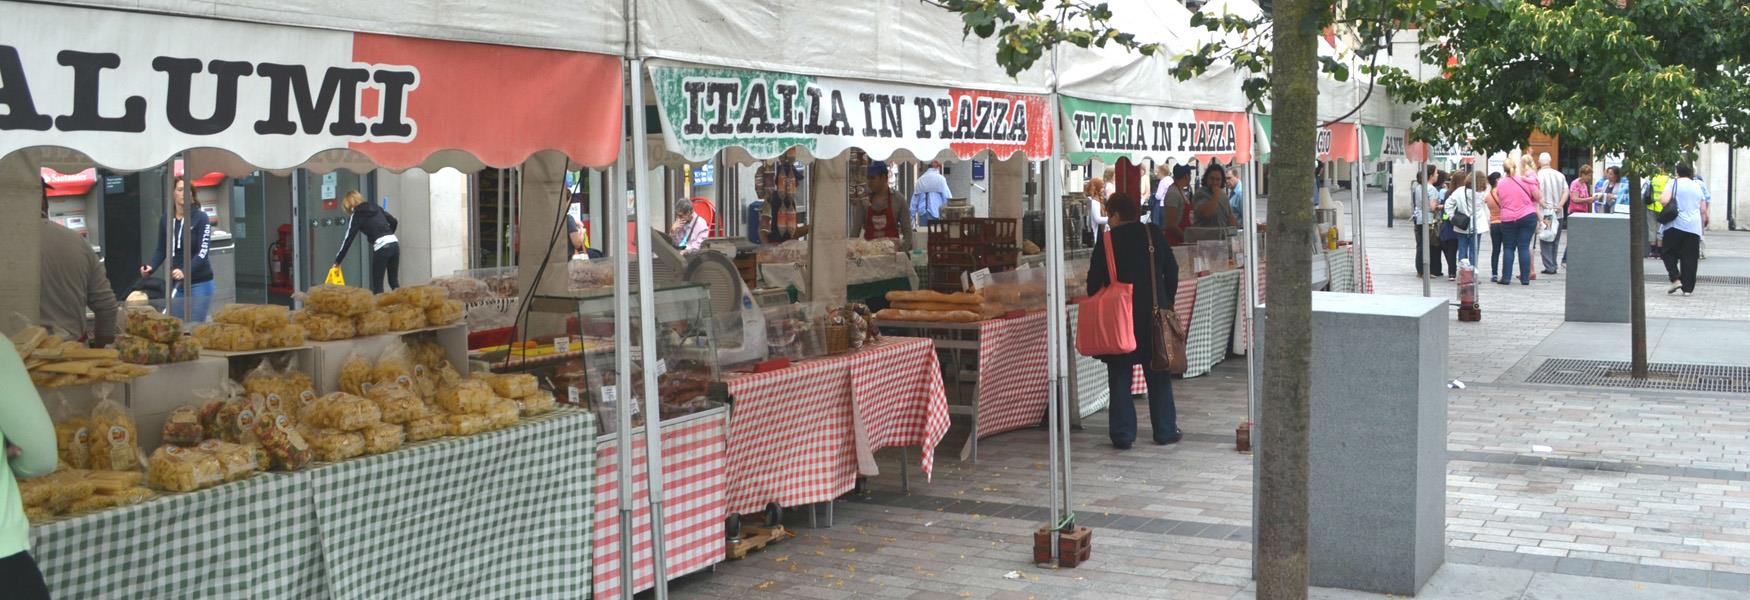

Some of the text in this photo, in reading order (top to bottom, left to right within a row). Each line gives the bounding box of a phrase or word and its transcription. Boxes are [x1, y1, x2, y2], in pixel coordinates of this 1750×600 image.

[683, 80, 1028, 141] ITALIA IN PIAZZA
[1074, 113, 1236, 151] ITALIA IN PIAZZA
